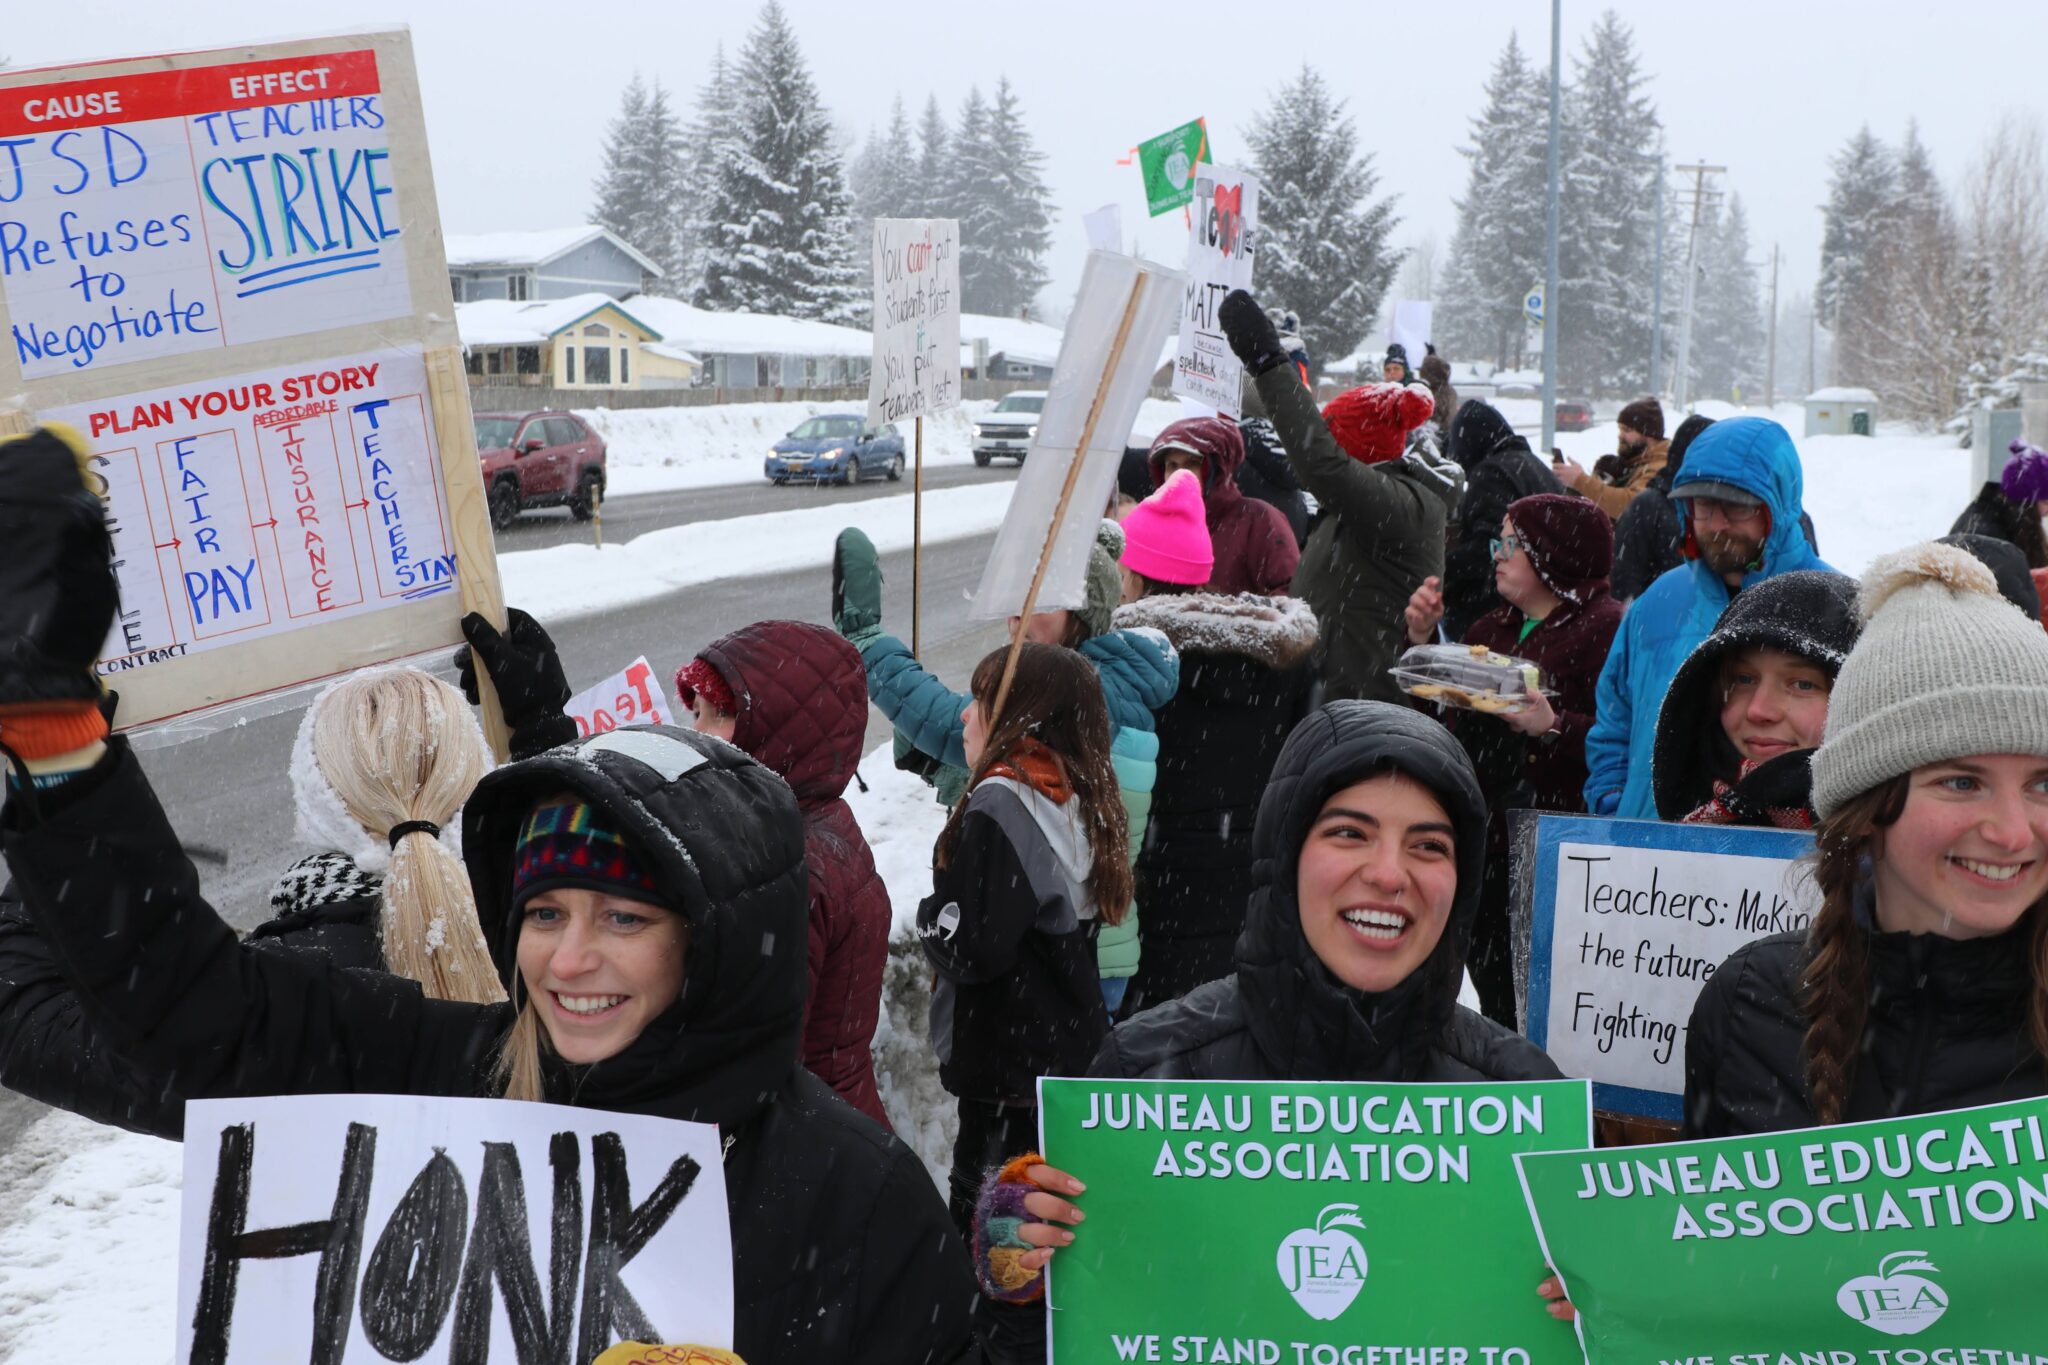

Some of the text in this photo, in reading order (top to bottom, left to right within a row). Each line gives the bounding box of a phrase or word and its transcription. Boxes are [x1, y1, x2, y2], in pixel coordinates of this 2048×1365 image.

[23, 67, 331, 122] CAUSE EFFECT
[194, 97, 385, 146] TEACHERS
[0, 126, 148, 202] JSD
[202, 147, 400, 272] STRIKE
[0, 211, 191, 275] Refuses
[879, 227, 952, 290] You can't put
[70, 264, 125, 302] to
[928, 278, 950, 316] first
[12, 289, 218, 368] Negotiate
[916, 319, 925, 352] if
[914, 338, 936, 385] put
[1179, 352, 1216, 378] spellcheck
[89, 363, 379, 438] PLAN YOUR STORY
[253, 399, 338, 426] AFFORDABLE
[174, 436, 221, 554] FAIR
[275, 424, 336, 611] INSURANCE
[184, 558, 256, 624] PAY
[396, 554, 458, 587] STAY
[1568, 855, 1728, 927] Teachers:
[1579, 932, 1716, 982] the future
[1572, 992, 1676, 1065] Fighting
[1082, 1092, 1544, 1136] JUNEAU EDUCATION
[1153, 1140, 1470, 1183] ASSOCIATION
[1576, 1149, 1781, 1200] JUNEAU
[1672, 1173, 2048, 1240] ASSOCIATION
[190, 1120, 701, 1365] HONK
[1289, 1245, 1367, 1292] JEA
[1850, 1285, 1948, 1321] JEA
[1111, 1334, 1530, 1365] WE STAND TOGETHER TO
